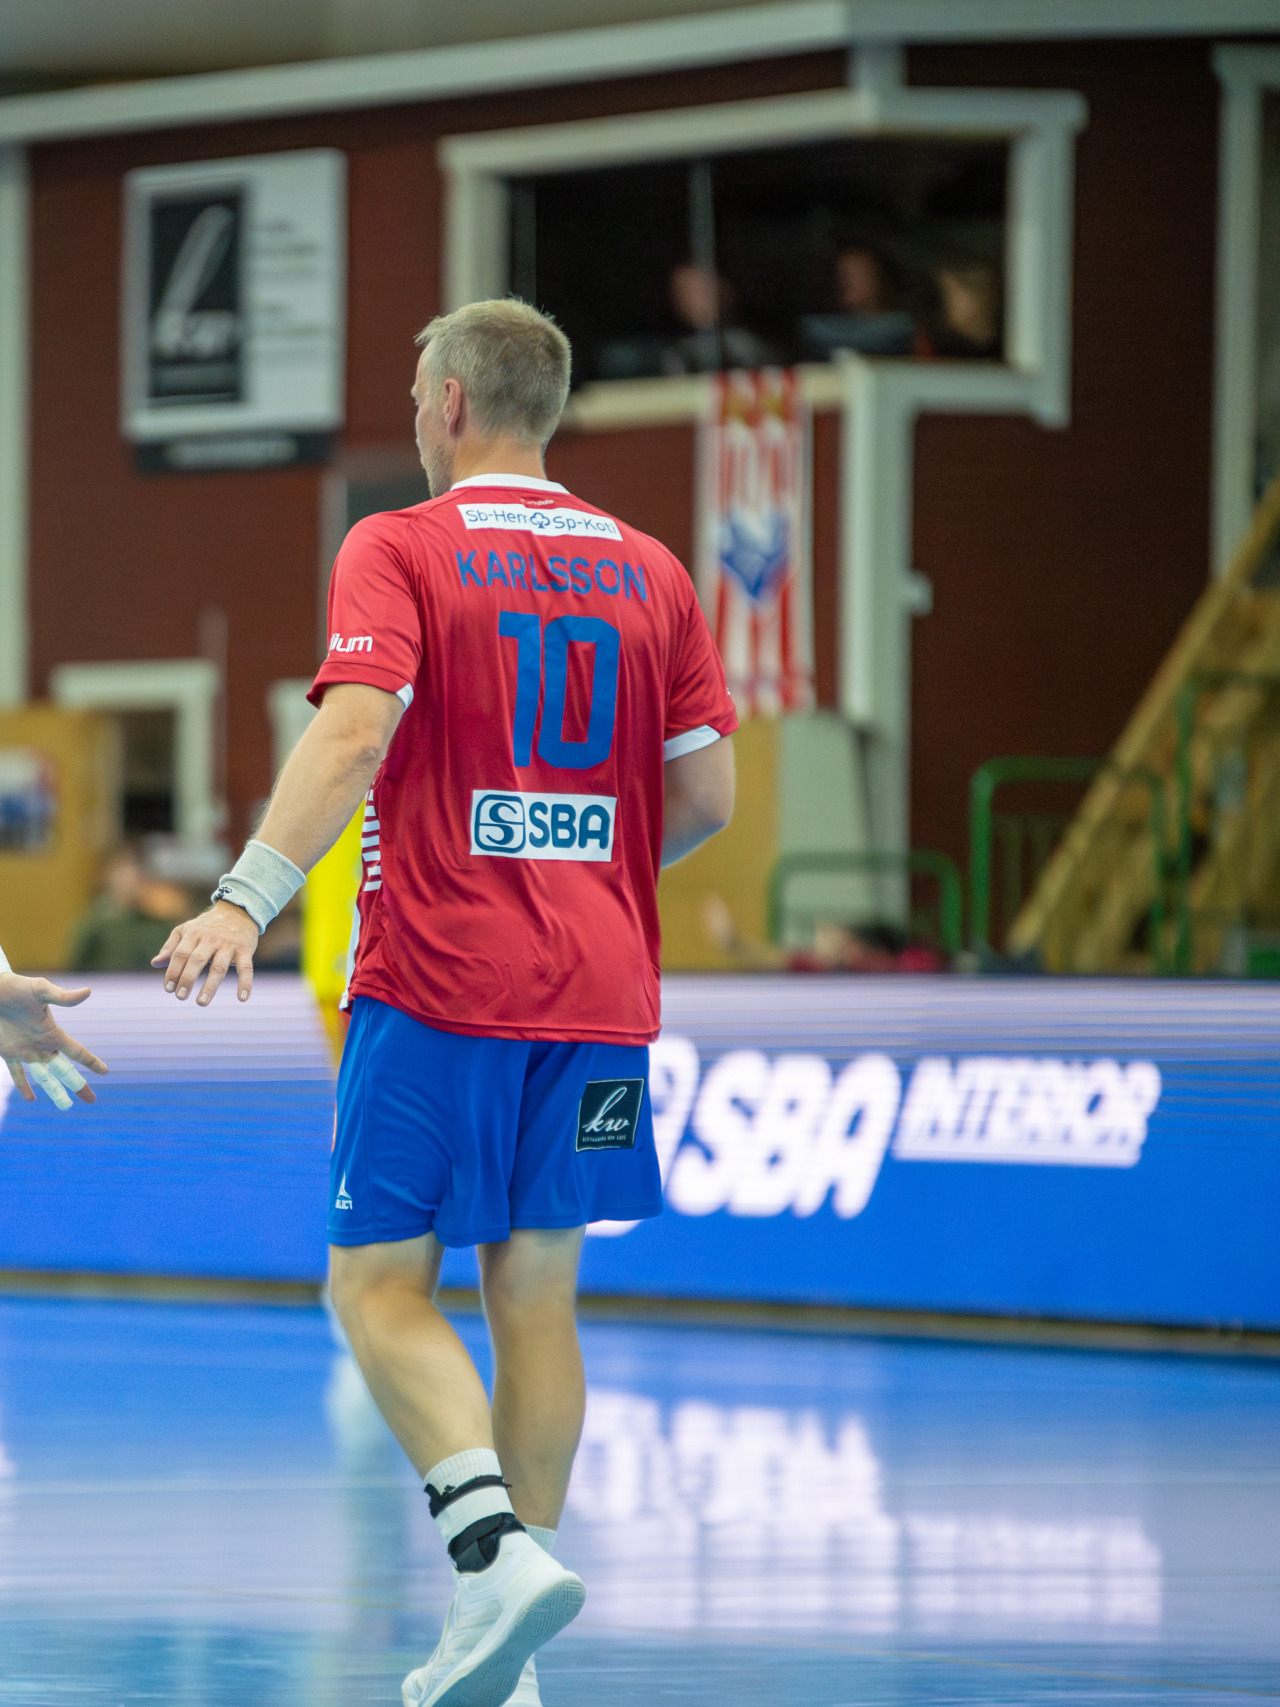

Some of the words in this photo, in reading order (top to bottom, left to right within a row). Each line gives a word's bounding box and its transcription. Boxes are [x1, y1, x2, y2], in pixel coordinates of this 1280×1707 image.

[455, 550, 648, 602] KARLSSON
[498, 611, 621, 770] 10
[528, 801, 611, 850] SBA
[667, 1049, 902, 1219] SBA
